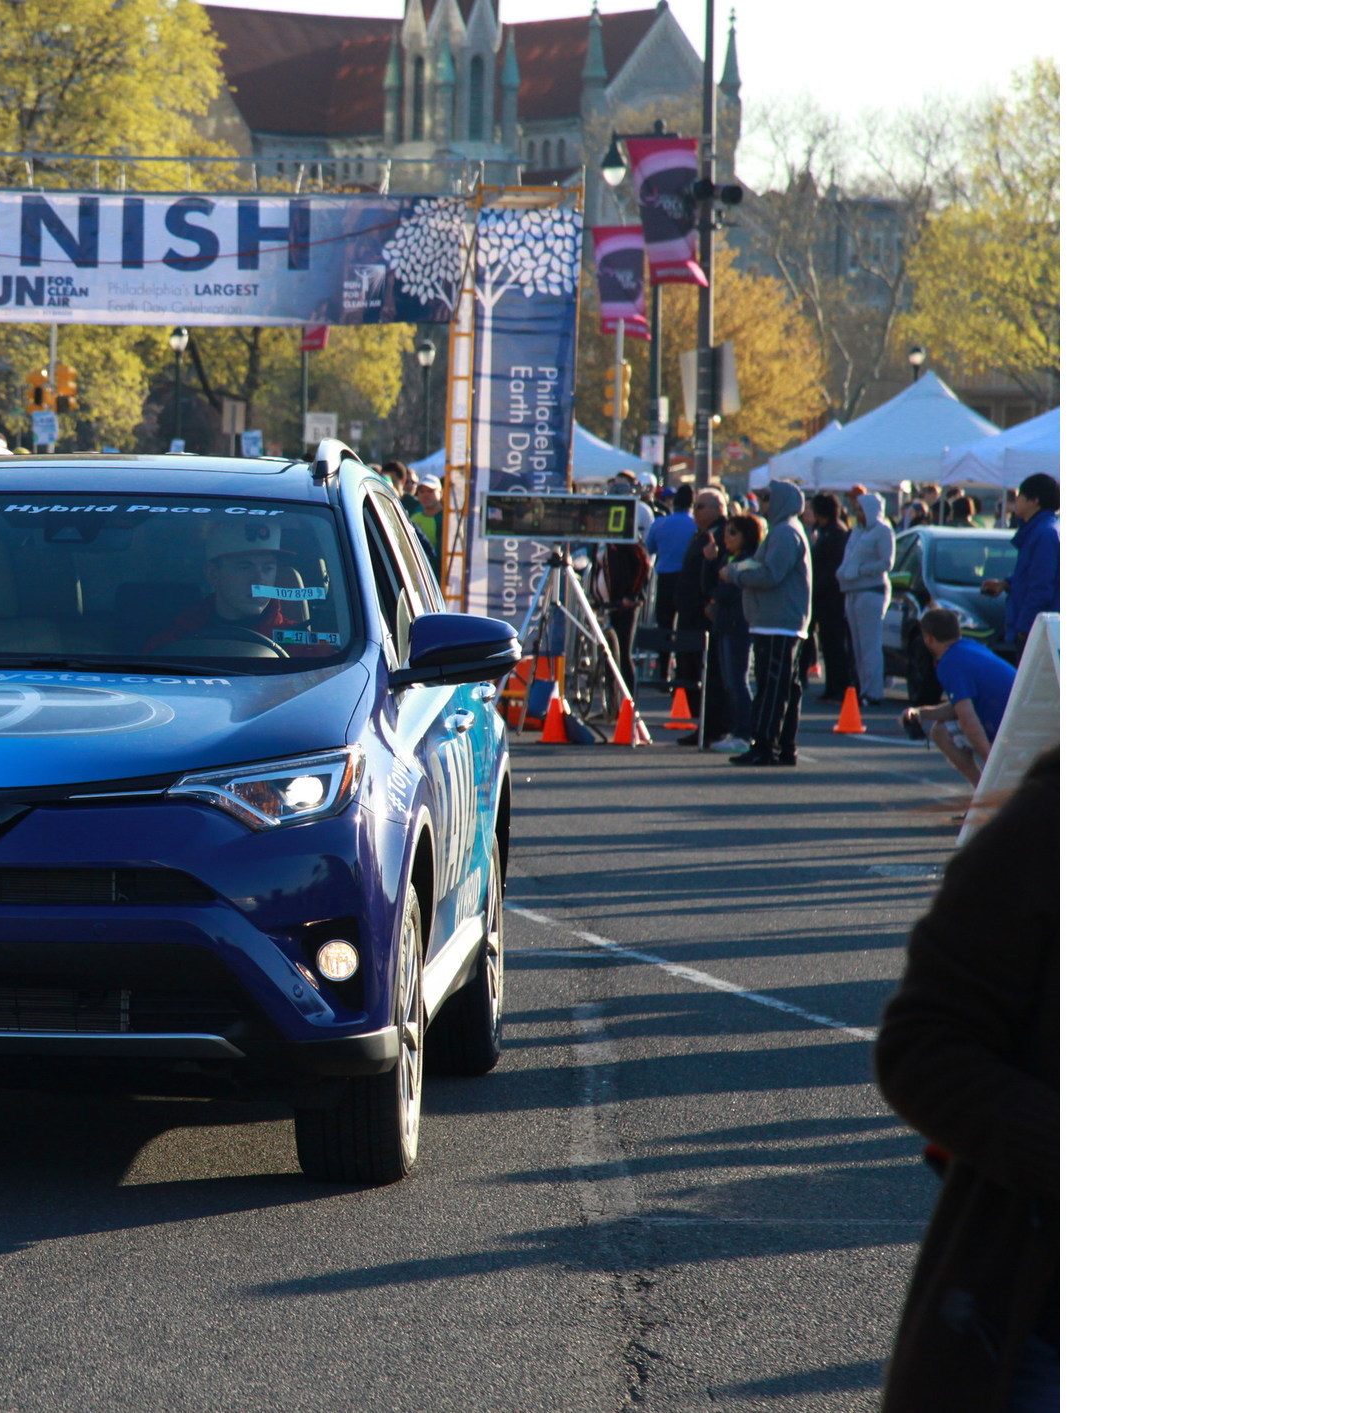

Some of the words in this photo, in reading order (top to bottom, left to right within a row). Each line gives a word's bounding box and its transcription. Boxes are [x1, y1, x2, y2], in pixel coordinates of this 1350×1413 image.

[47, 276, 75, 287] FOR
[47, 287, 90, 298] CLEAN
[194, 283, 260, 297] LARGEST
[47, 297, 71, 308] AIR
[509, 366, 532, 424] Earth
[531, 366, 559, 494] Philadelphi
[502, 433, 530, 477] Day
[3, 504, 119, 514] Hybrid
[125, 504, 212, 515] Pace
[224, 506, 285, 516] Car
